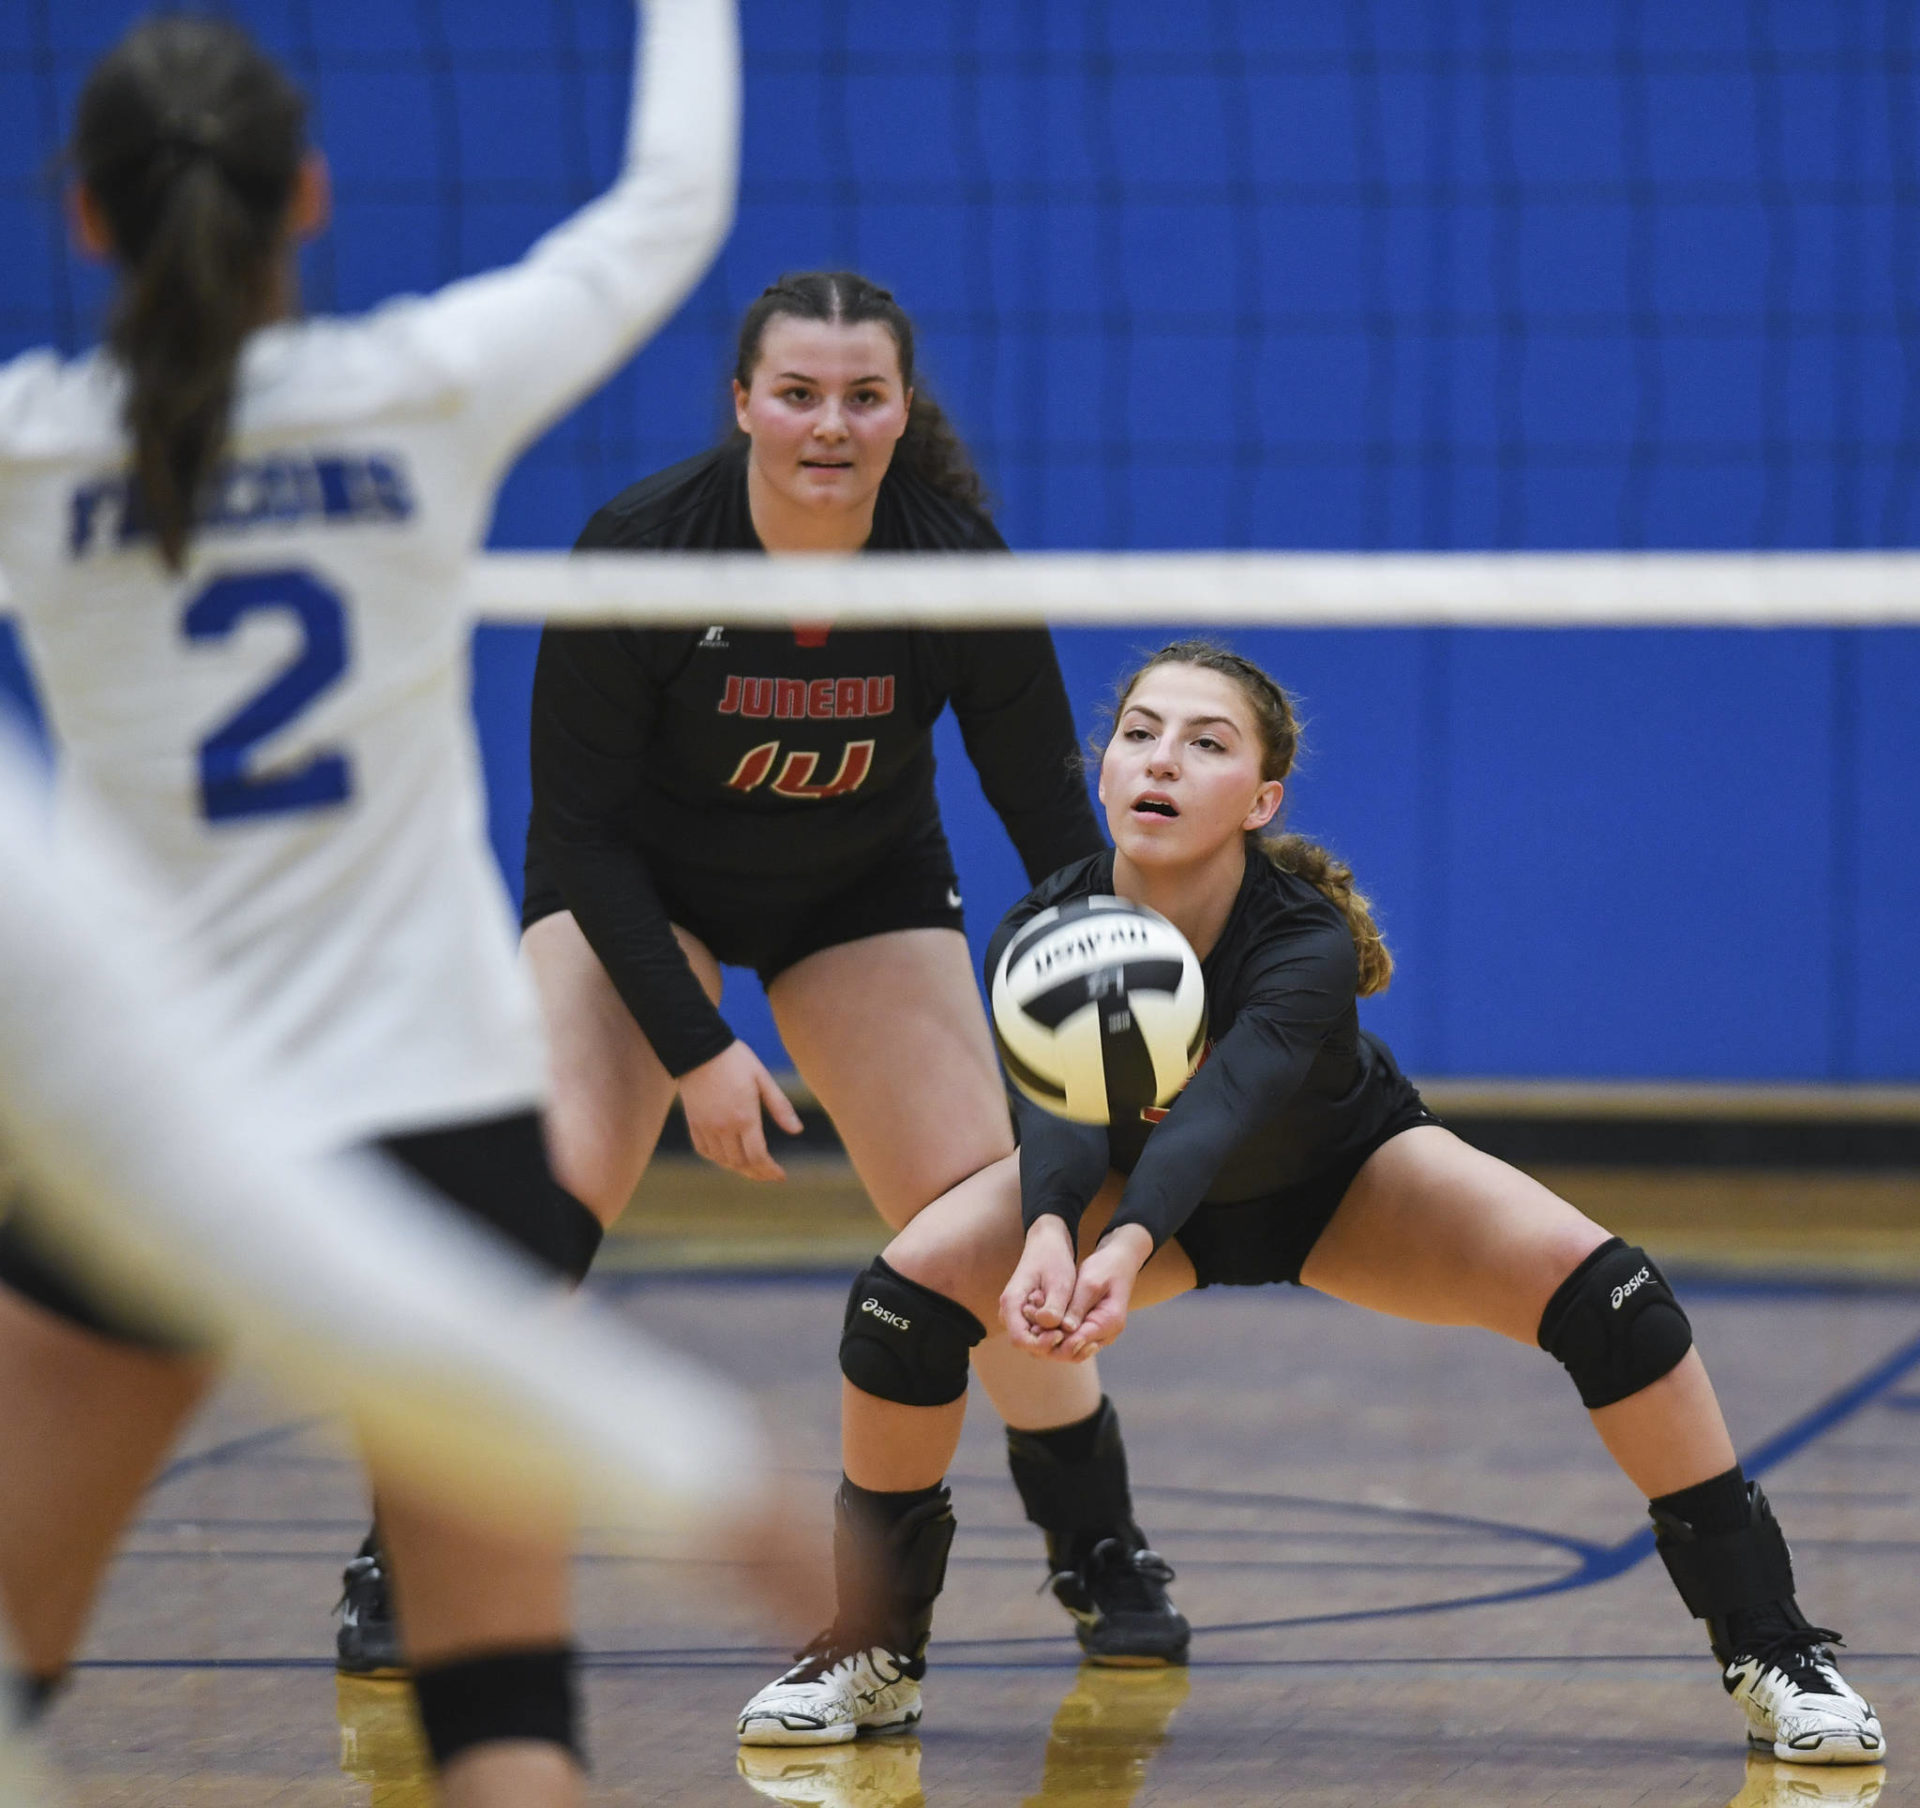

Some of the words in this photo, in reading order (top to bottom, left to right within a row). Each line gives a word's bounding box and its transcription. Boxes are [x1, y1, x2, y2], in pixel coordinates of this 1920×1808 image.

[182, 564, 353, 824] 2
[718, 674, 895, 719] JUNEAU
[1622, 1264, 1651, 1298] asics
[873, 1304, 911, 1331] asics
